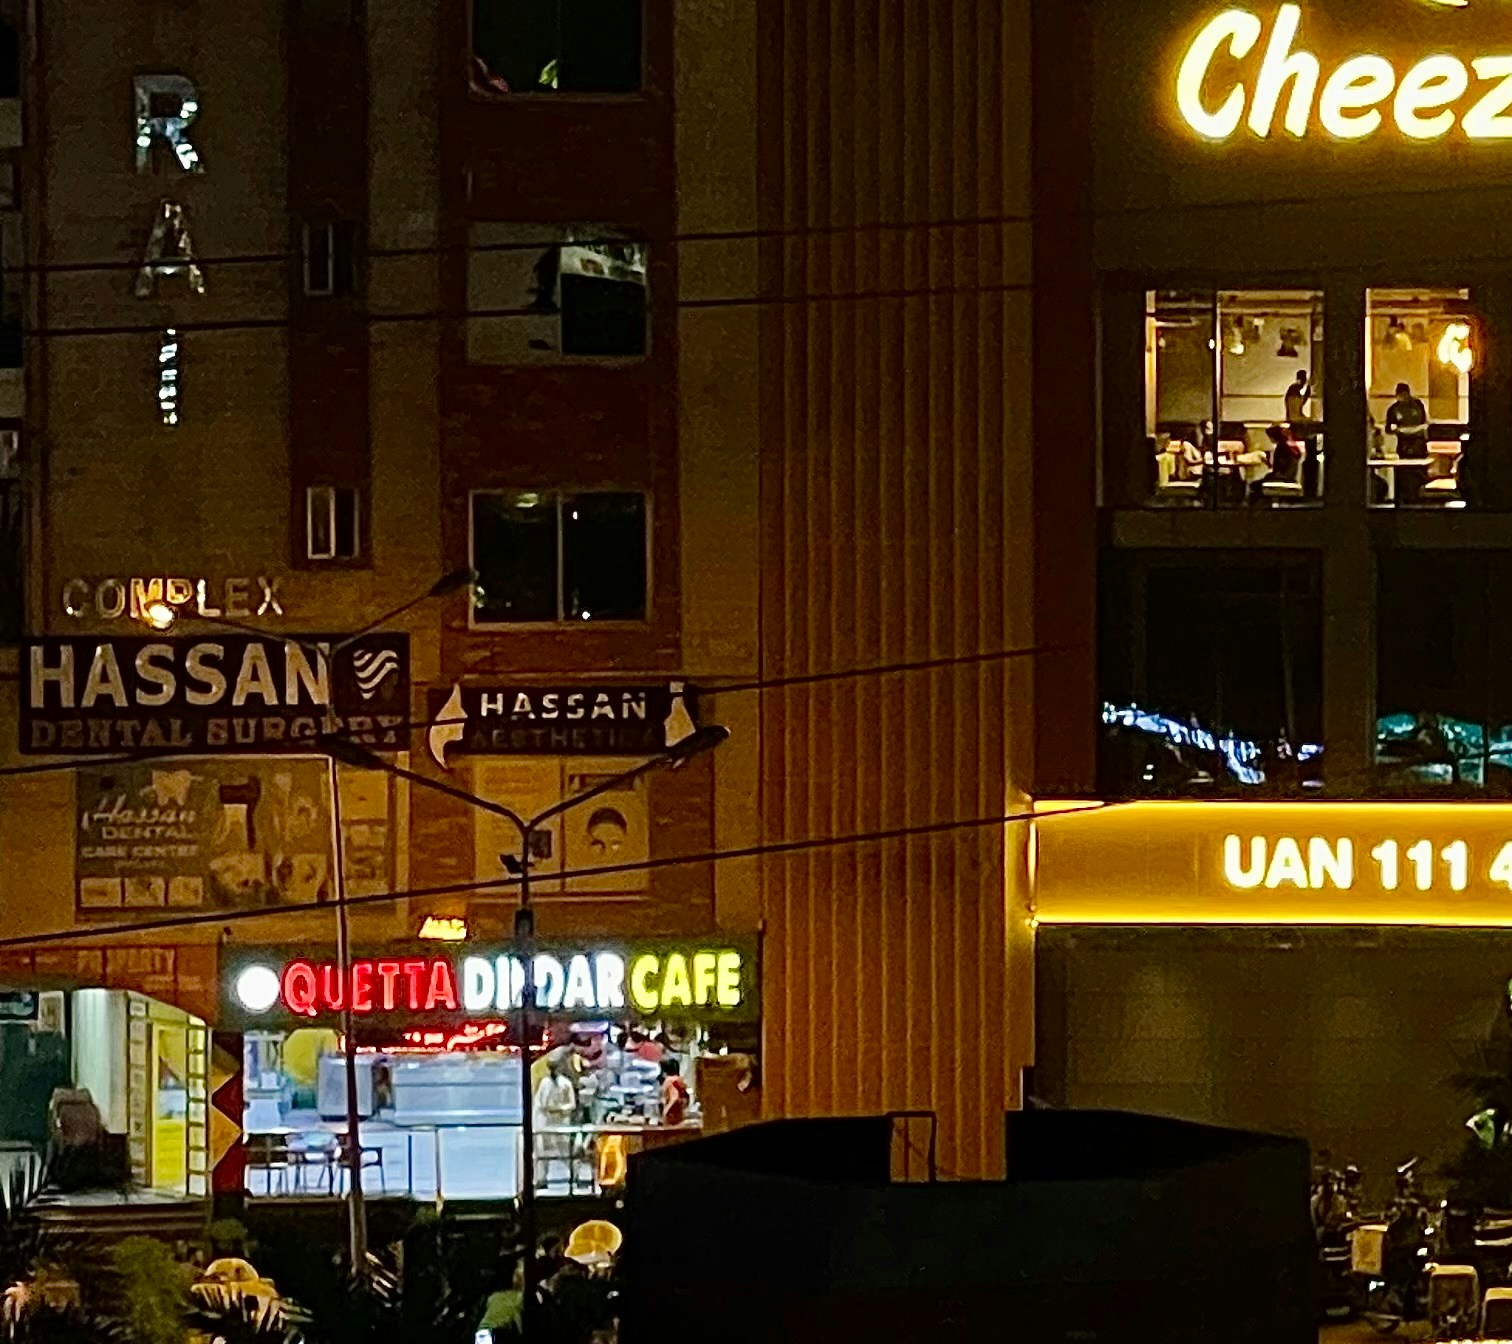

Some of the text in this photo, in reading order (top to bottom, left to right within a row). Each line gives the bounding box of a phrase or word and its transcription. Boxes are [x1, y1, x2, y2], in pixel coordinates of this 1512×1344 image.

[62, 576, 284, 619] COMPLEX
[28, 641, 332, 709] HASSAN
[480, 691, 647, 720] HASSAN
[30, 717, 193, 748] DENTAL
[1222, 833, 1354, 892] UAN
[1371, 837, 1469, 892] 111
[283, 960, 458, 1017] QUETTA
[629, 952, 743, 1011] CAFE
